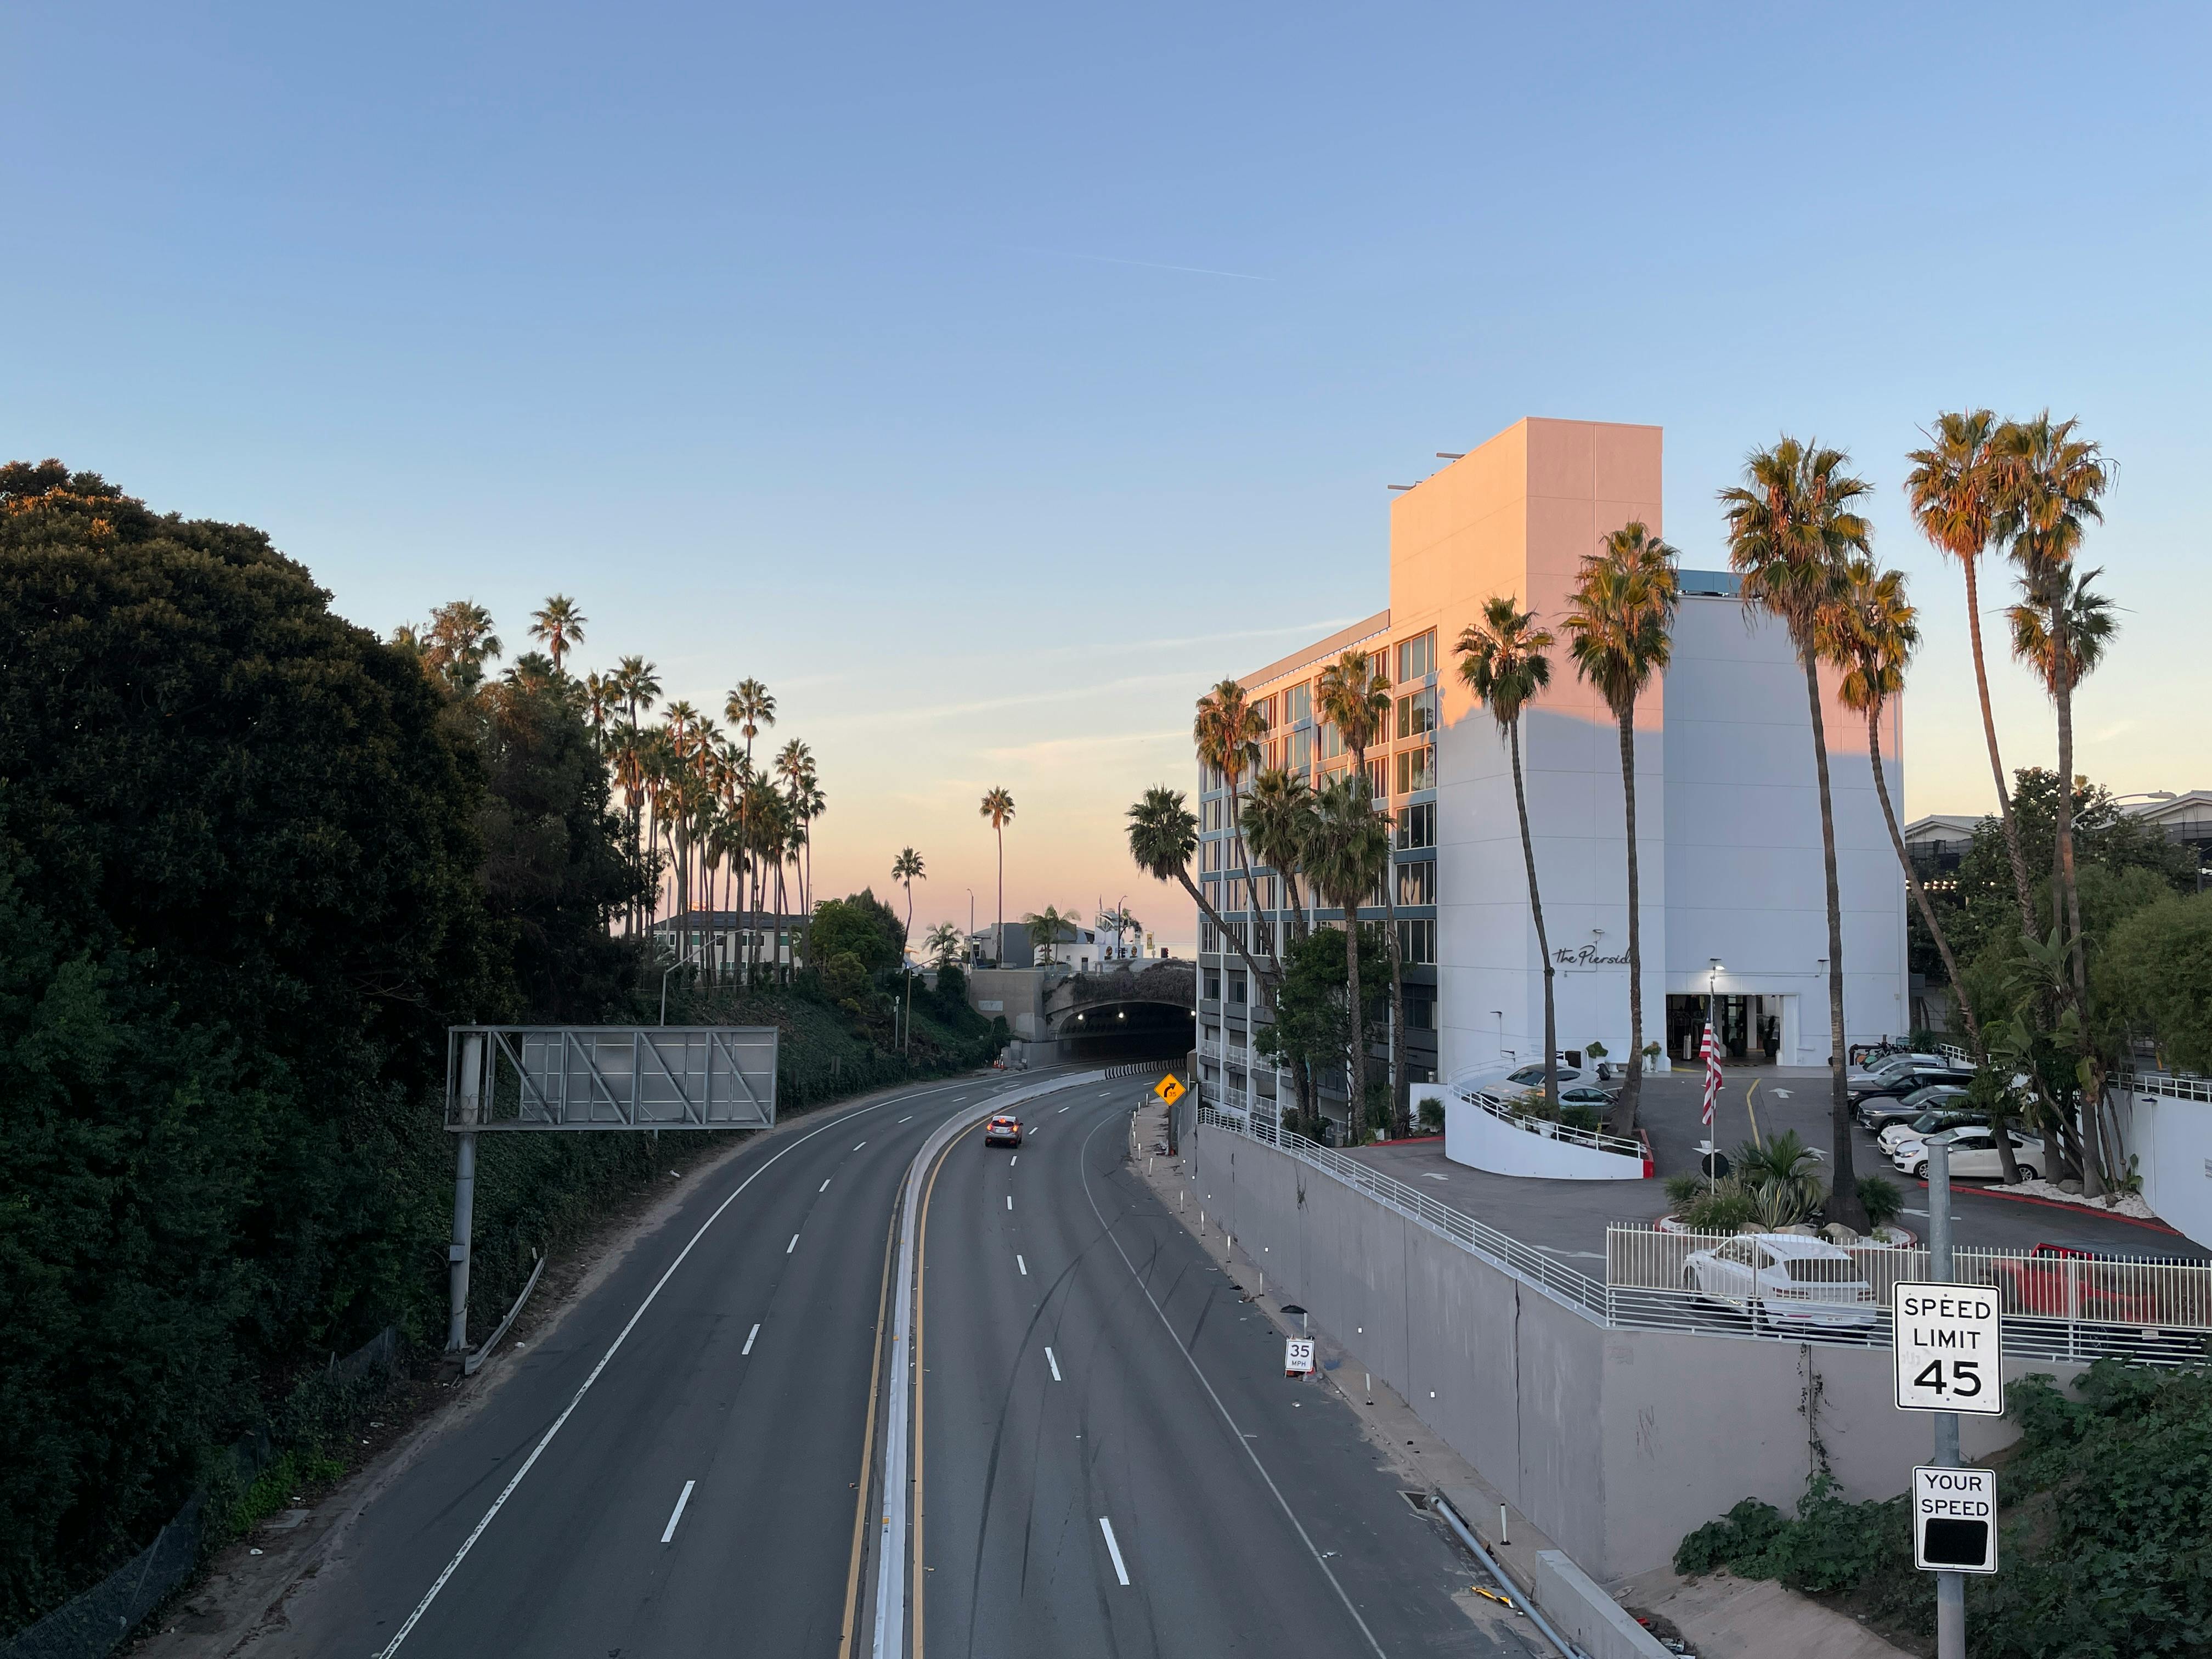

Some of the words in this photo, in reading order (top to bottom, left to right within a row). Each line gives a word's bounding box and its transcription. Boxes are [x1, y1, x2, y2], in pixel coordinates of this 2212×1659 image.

[1578, 945, 1631, 966] Piersid
[1904, 1298, 1990, 1319] SPEED
[1914, 1328, 1980, 1350] LIMIT
[1290, 1345, 1309, 1357] 35
[1914, 1359, 1981, 1396] 45
[1925, 1474, 1982, 1491] YOUR
[1921, 1499, 1989, 1516] SPEED
